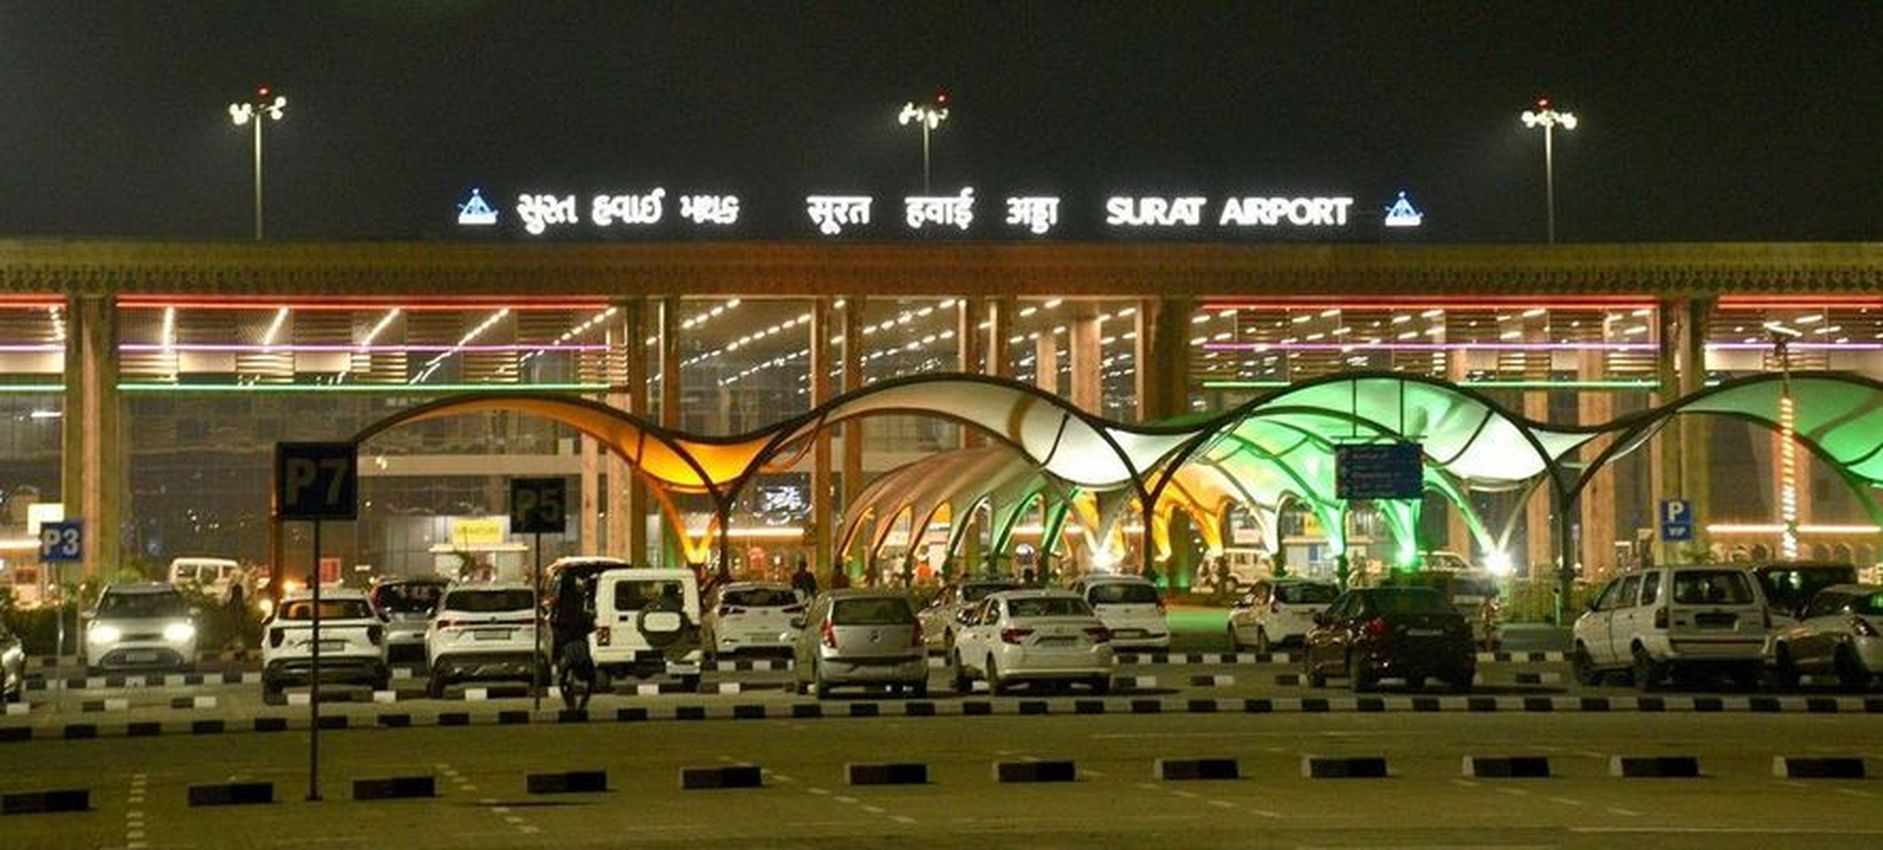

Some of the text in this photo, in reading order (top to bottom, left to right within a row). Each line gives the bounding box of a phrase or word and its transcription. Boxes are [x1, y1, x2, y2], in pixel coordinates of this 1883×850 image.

[516, 187, 740, 235] સુરત હવાઈ મથક
[806, 186, 1060, 235] सूरत हवाई अड्डा
[1106, 196, 1354, 226] SURAT AIRPORT
[285, 458, 349, 506] P7
[516, 489, 560, 522] P5
[1668, 501, 1684, 522] P
[43, 527, 80, 557] P3
